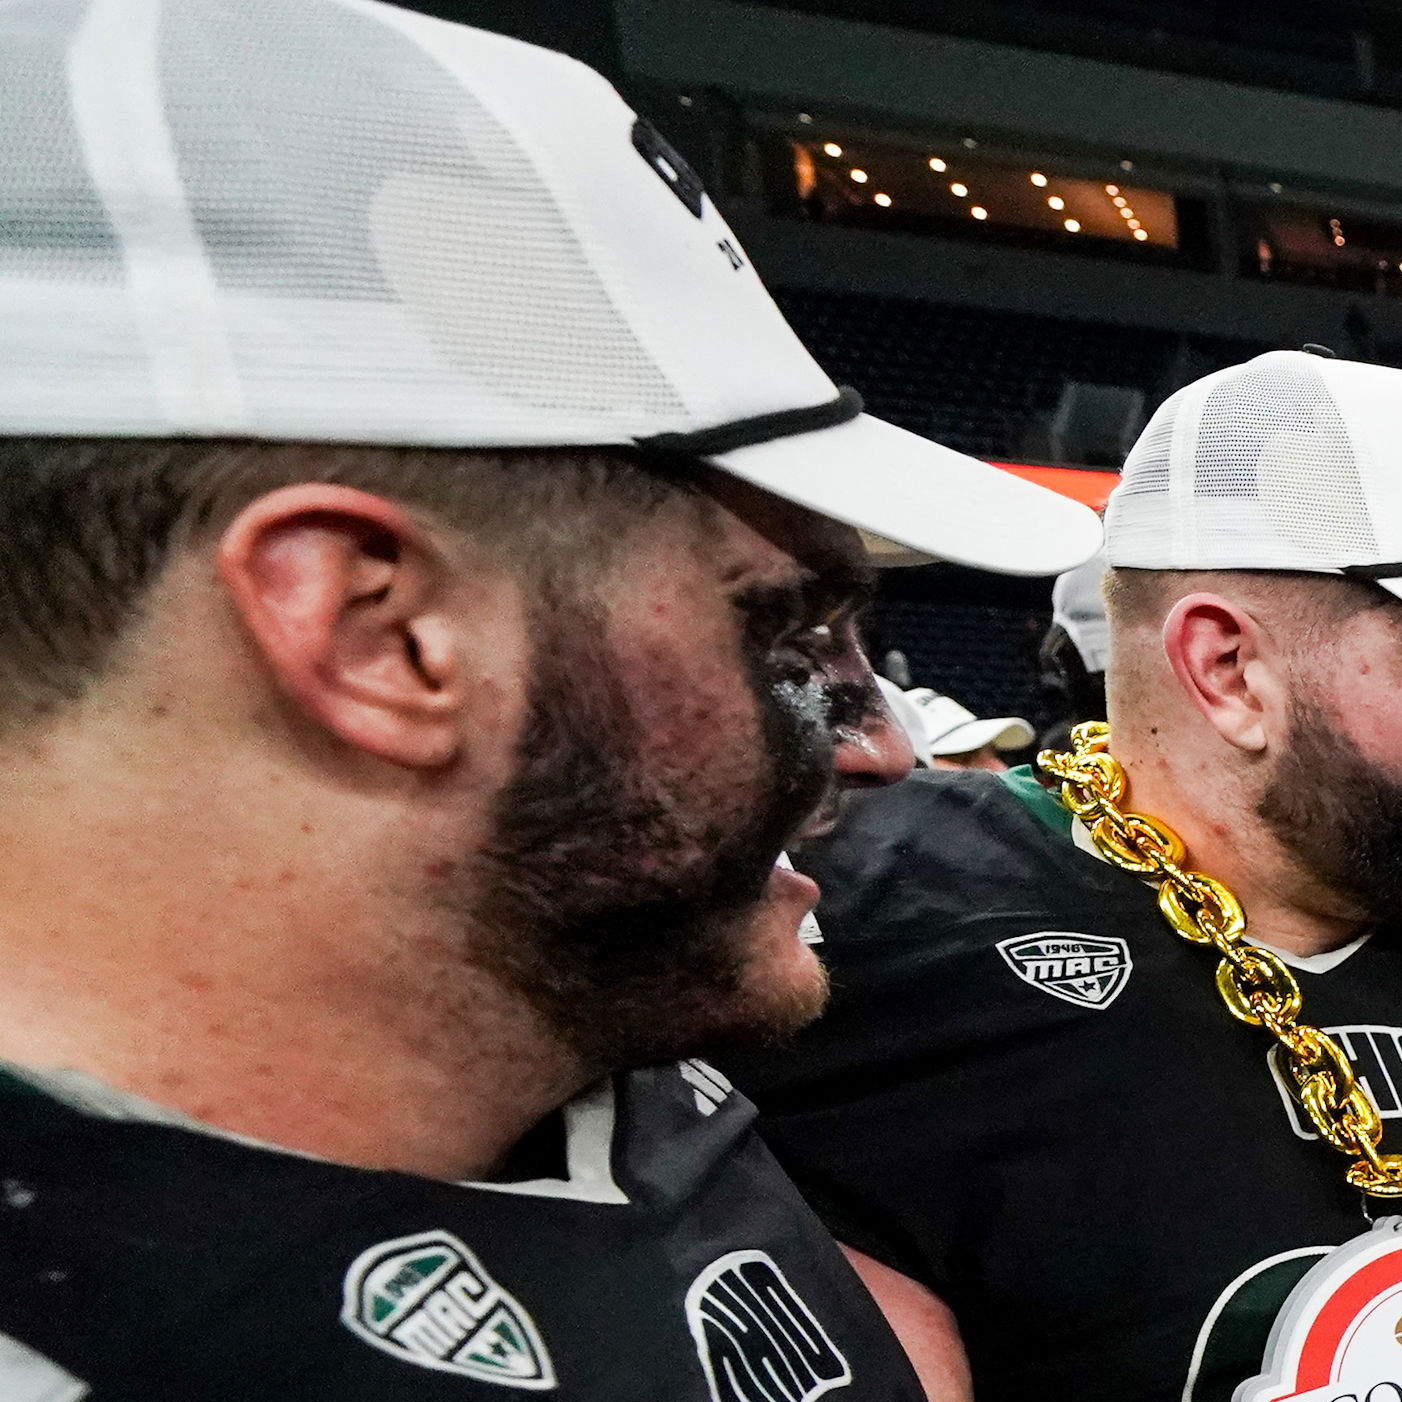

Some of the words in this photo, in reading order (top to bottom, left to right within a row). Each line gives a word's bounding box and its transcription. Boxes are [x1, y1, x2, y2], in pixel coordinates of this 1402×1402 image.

[1045, 943, 1081, 955] 1946
[1022, 956, 1120, 982] MAC
[390, 1270, 485, 1361] MAC
